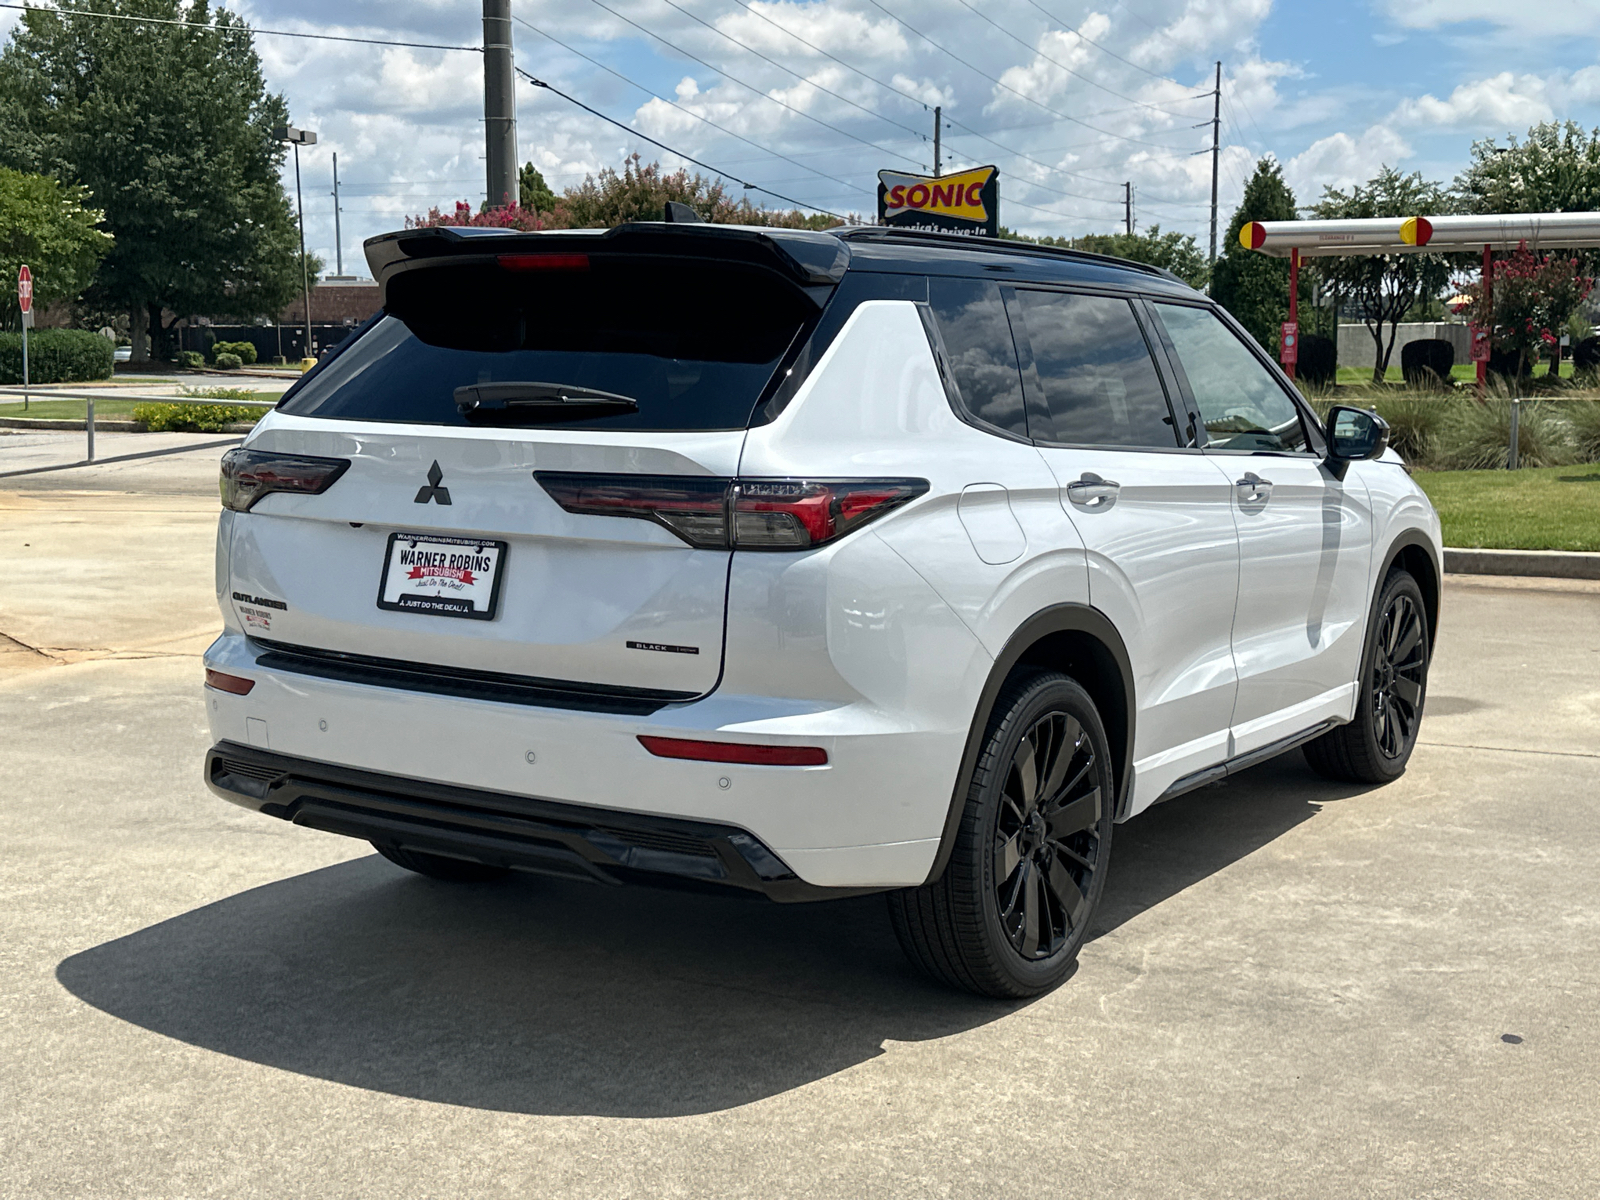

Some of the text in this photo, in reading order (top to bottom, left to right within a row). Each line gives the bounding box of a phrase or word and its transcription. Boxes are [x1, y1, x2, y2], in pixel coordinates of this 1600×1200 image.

[888, 182, 984, 209] SONIC
[19, 280, 32, 298] STOP
[400, 550, 491, 572] WARNER ROBINS
[420, 567, 464, 579] MITSUBISHI
[415, 578, 465, 591] Just Do The Deal!
[232, 591, 288, 611] OUTLANDER
[421, 601, 431, 609] DO
[444, 604, 463, 612] DEAL!
[636, 643, 667, 651] BLACK
